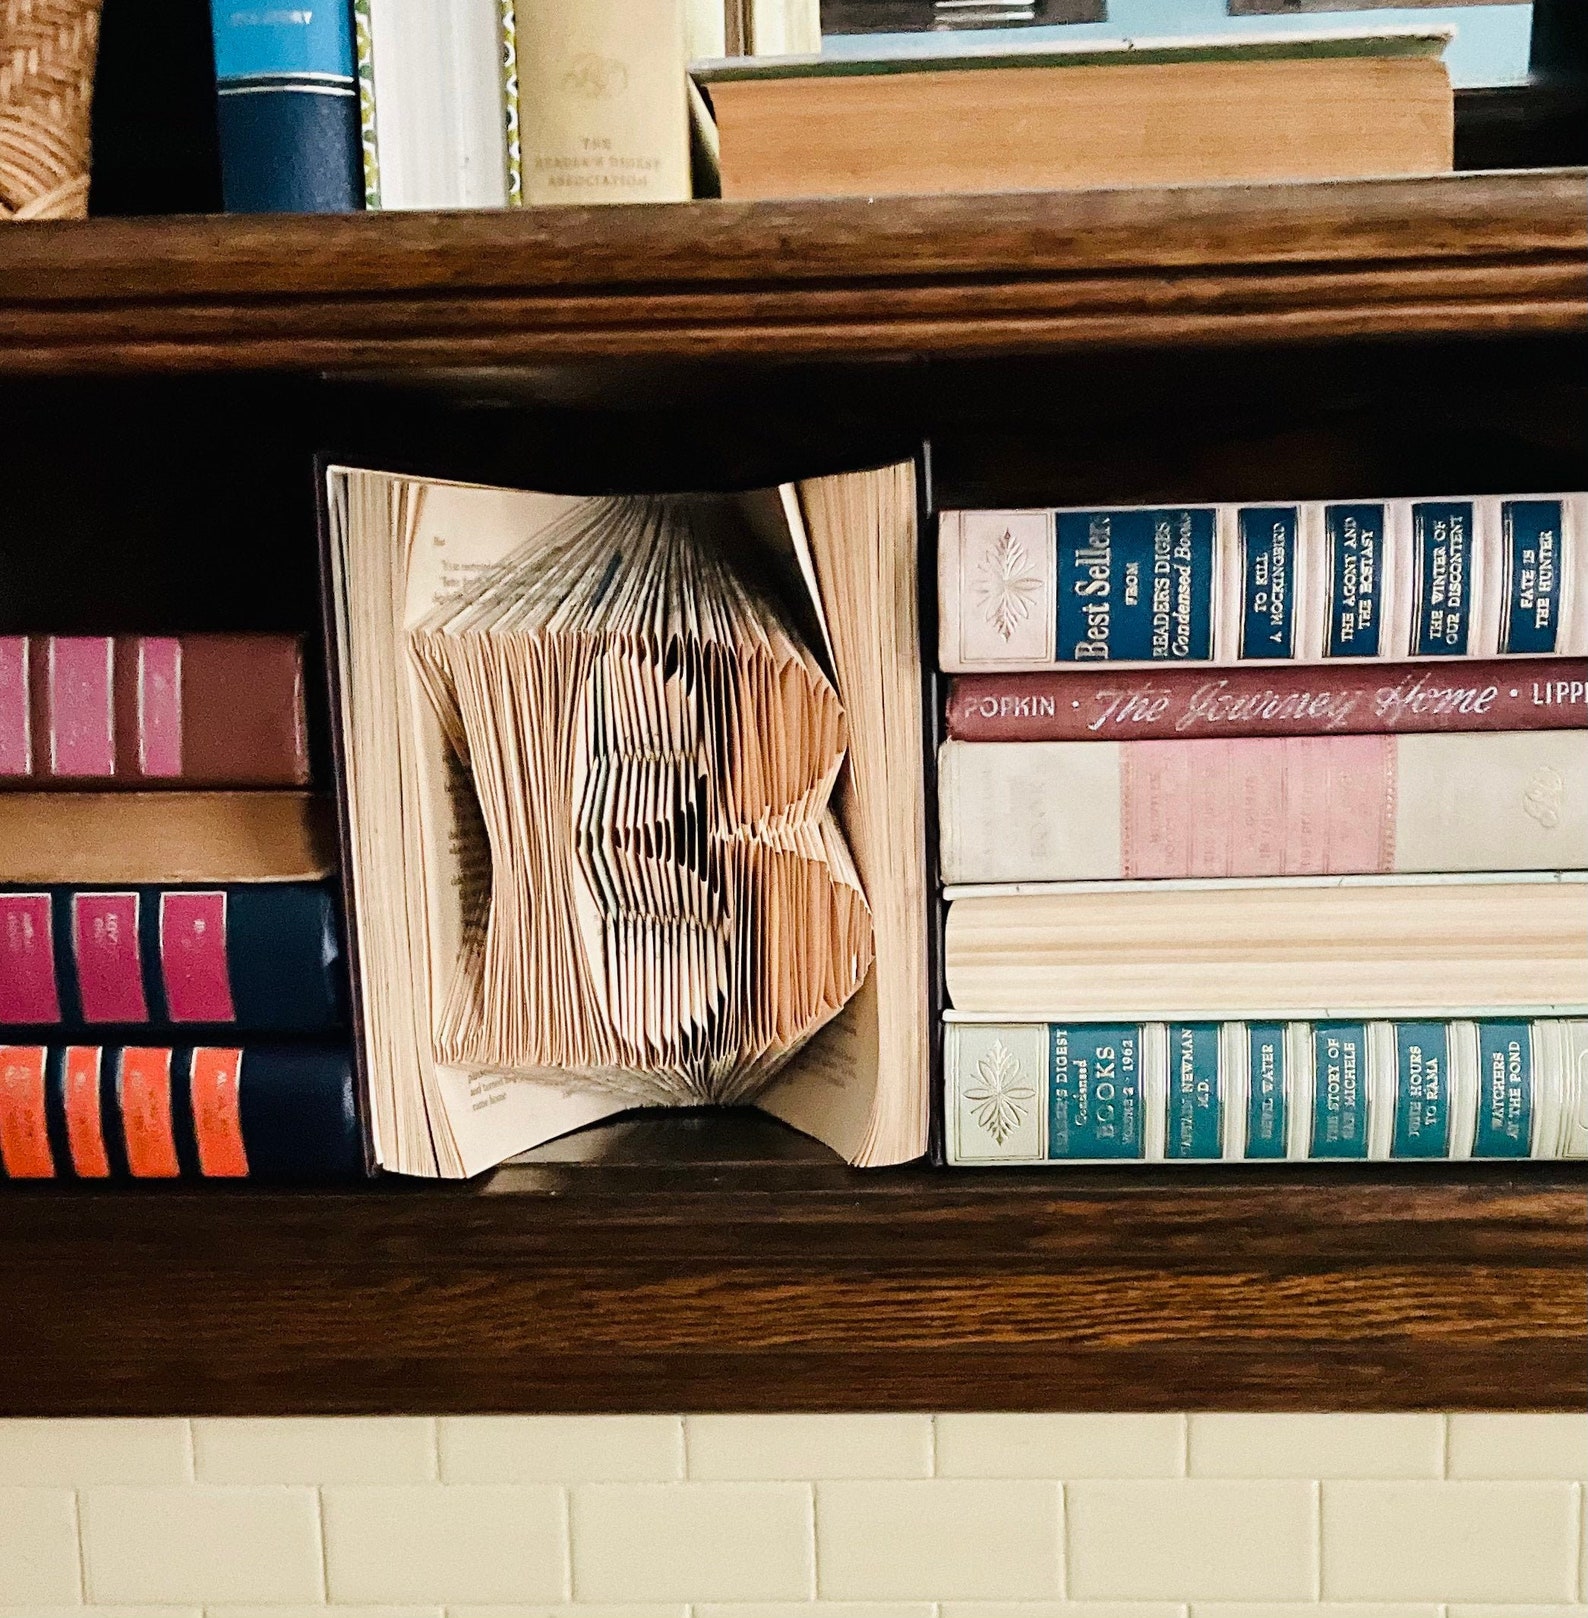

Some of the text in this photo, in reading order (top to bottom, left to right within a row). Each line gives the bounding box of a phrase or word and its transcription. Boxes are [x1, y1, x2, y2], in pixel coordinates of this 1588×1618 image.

[1153, 518, 1171, 574] DIGES
[1520, 549, 1535, 609] FATE IS
[1125, 562, 1139, 605] FROM
[1172, 563, 1192, 657] Condensed
[1255, 552, 1268, 612] TO KILL
[1269, 522, 1285, 643] A MOCKINGBIRD
[1341, 517, 1357, 643] THE AGONY AND
[1358, 530, 1375, 630] THE ECSTASY
[1430, 520, 1446, 640] THE WINTER OF
[1446, 515, 1463, 644] OUR DISCONTENT
[1535, 530, 1553, 629] THE HUNTER
[1074, 604, 1109, 660] Best
[964, 694, 1056, 718] POPKIN
[1087, 681, 1172, 731] The
[1175, 680, 1363, 731] Journey
[1375, 672, 1499, 727] Home
[1056, 1029, 1068, 1083] DIGEST
[1122, 1039, 1134, 1072] 1962
[1181, 1028, 1193, 1093] NEWMAN
[1262, 1043, 1274, 1094] WATER
[1344, 1042, 1355, 1107] MICHELE
[1409, 1045, 1422, 1096] HOURS
[1073, 1058, 1088, 1127] Condensed
[1095, 1046, 1116, 1139] BOOKS
[1197, 1078, 1209, 1108] M.D.
[1327, 1038, 1340, 1142] THE STORY OF
[1425, 1057, 1438, 1125] TO RAMA
[1492, 1052, 1505, 1130] WATCHERS
[1506, 1041, 1521, 1140] AT THE POND
